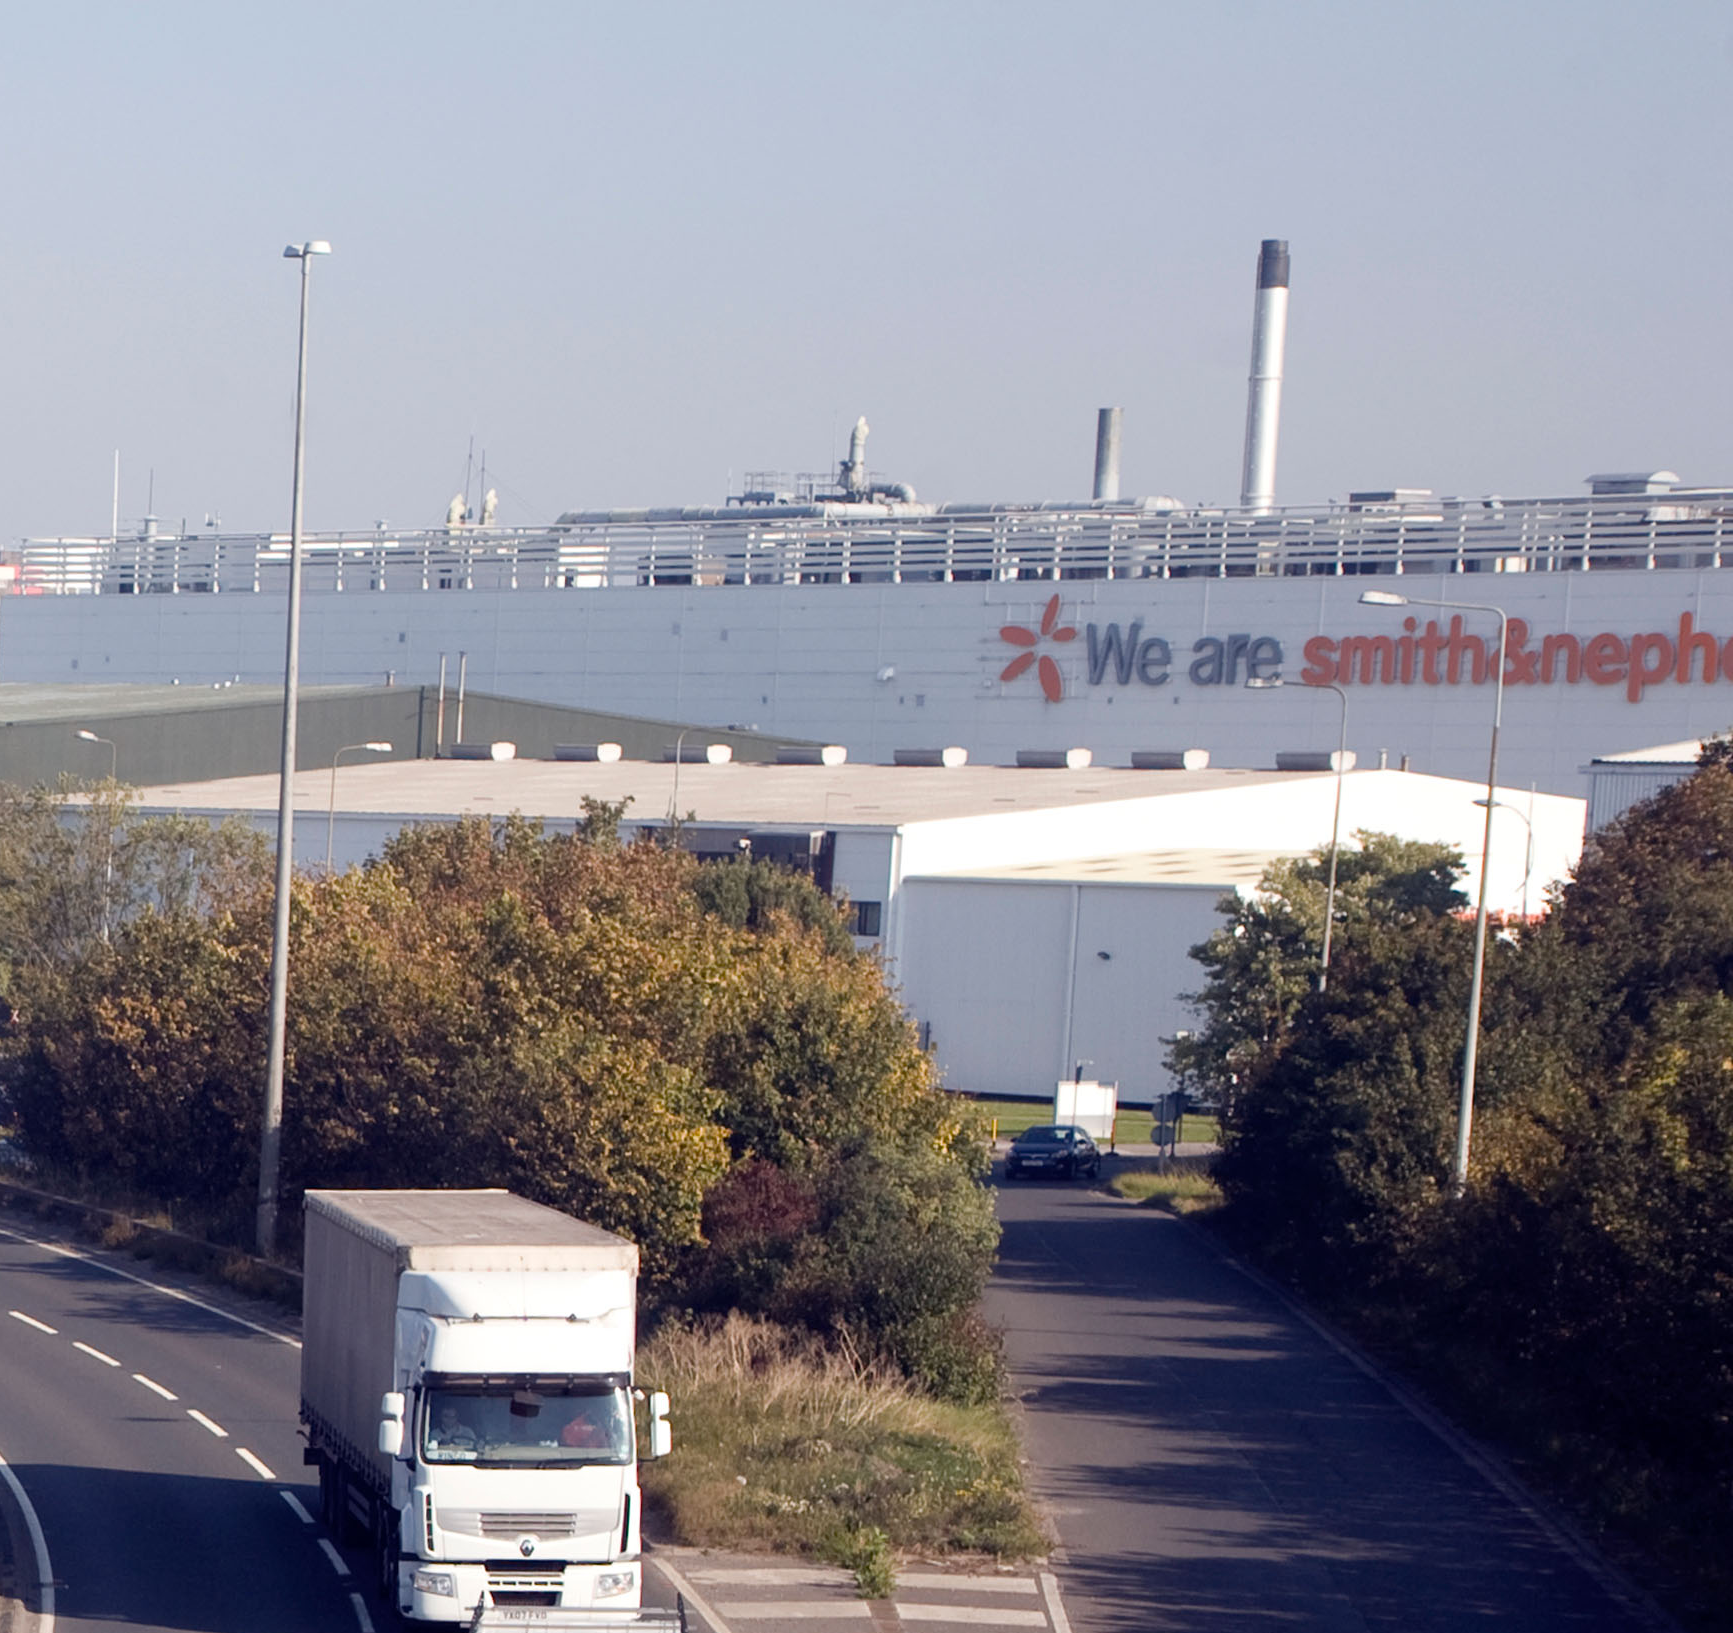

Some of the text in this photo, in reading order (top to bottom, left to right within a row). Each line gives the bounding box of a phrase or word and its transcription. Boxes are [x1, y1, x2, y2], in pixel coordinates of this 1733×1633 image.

[1086, 612, 1733, 704] We are smith&neph
